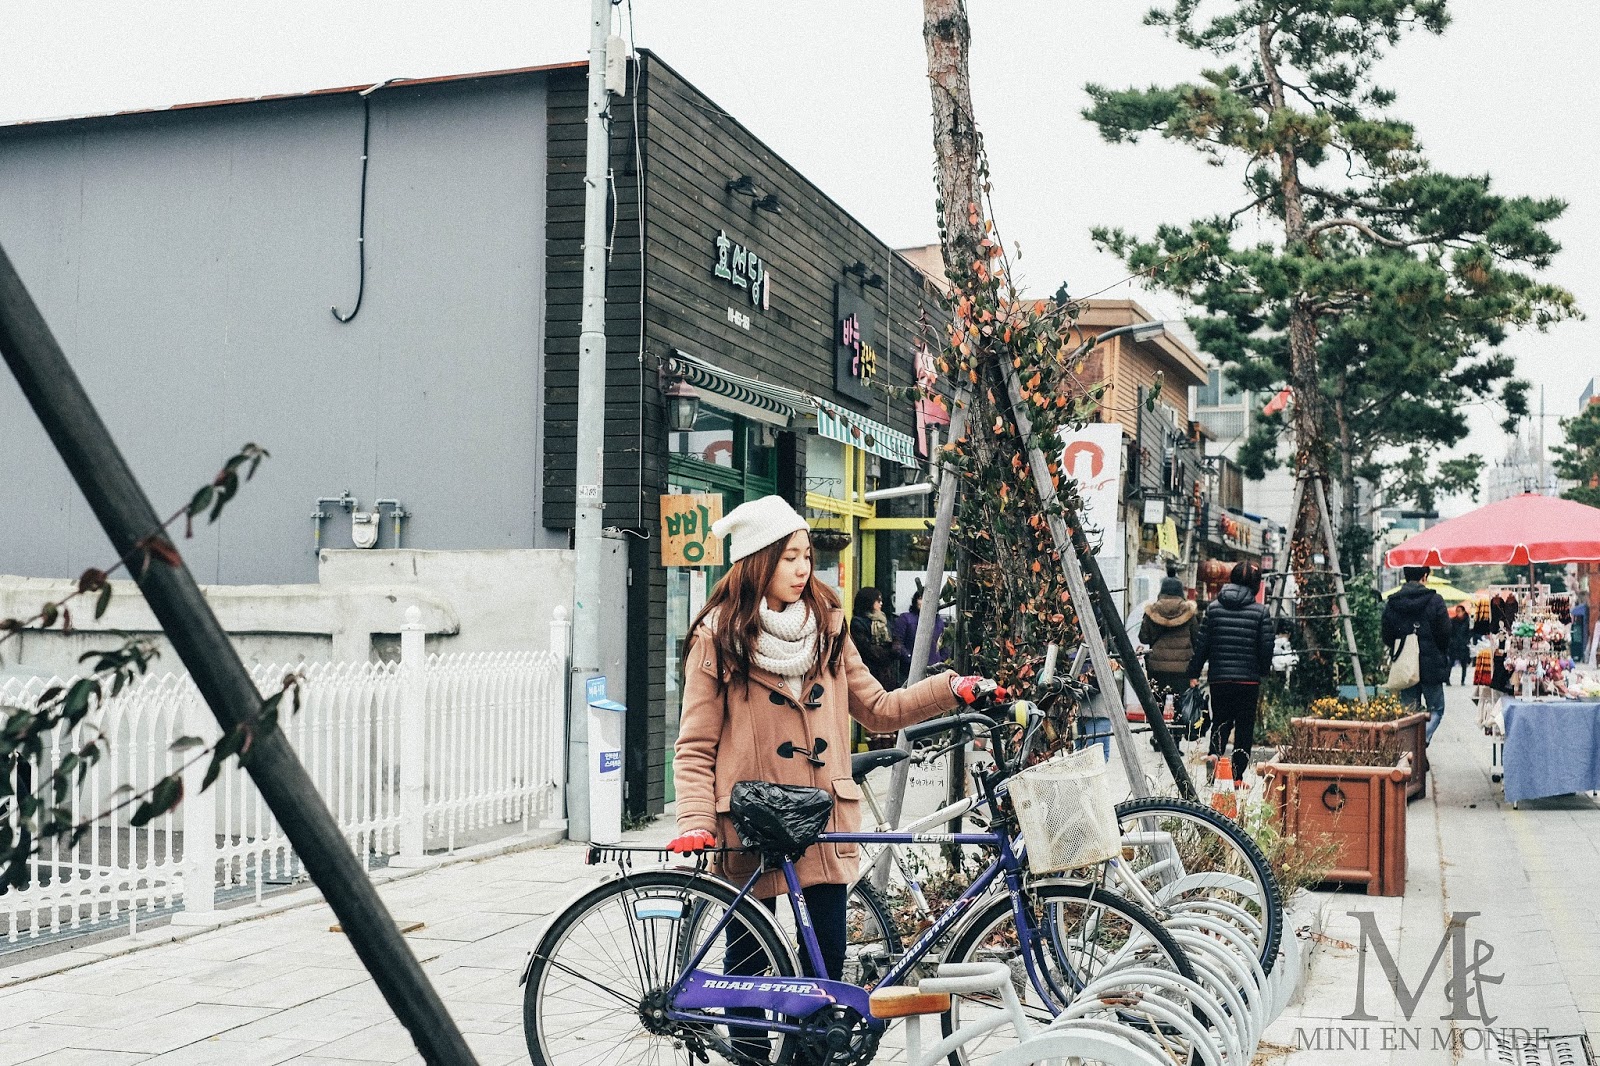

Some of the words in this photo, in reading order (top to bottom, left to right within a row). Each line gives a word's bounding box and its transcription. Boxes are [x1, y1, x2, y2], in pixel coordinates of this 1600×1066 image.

[665, 504, 713, 562] 빵
[890, 942, 922, 977] ROAD
[924, 902, 960, 942] STAR
[702, 980, 755, 991] ROAD
[758, 983, 813, 994] STAR
